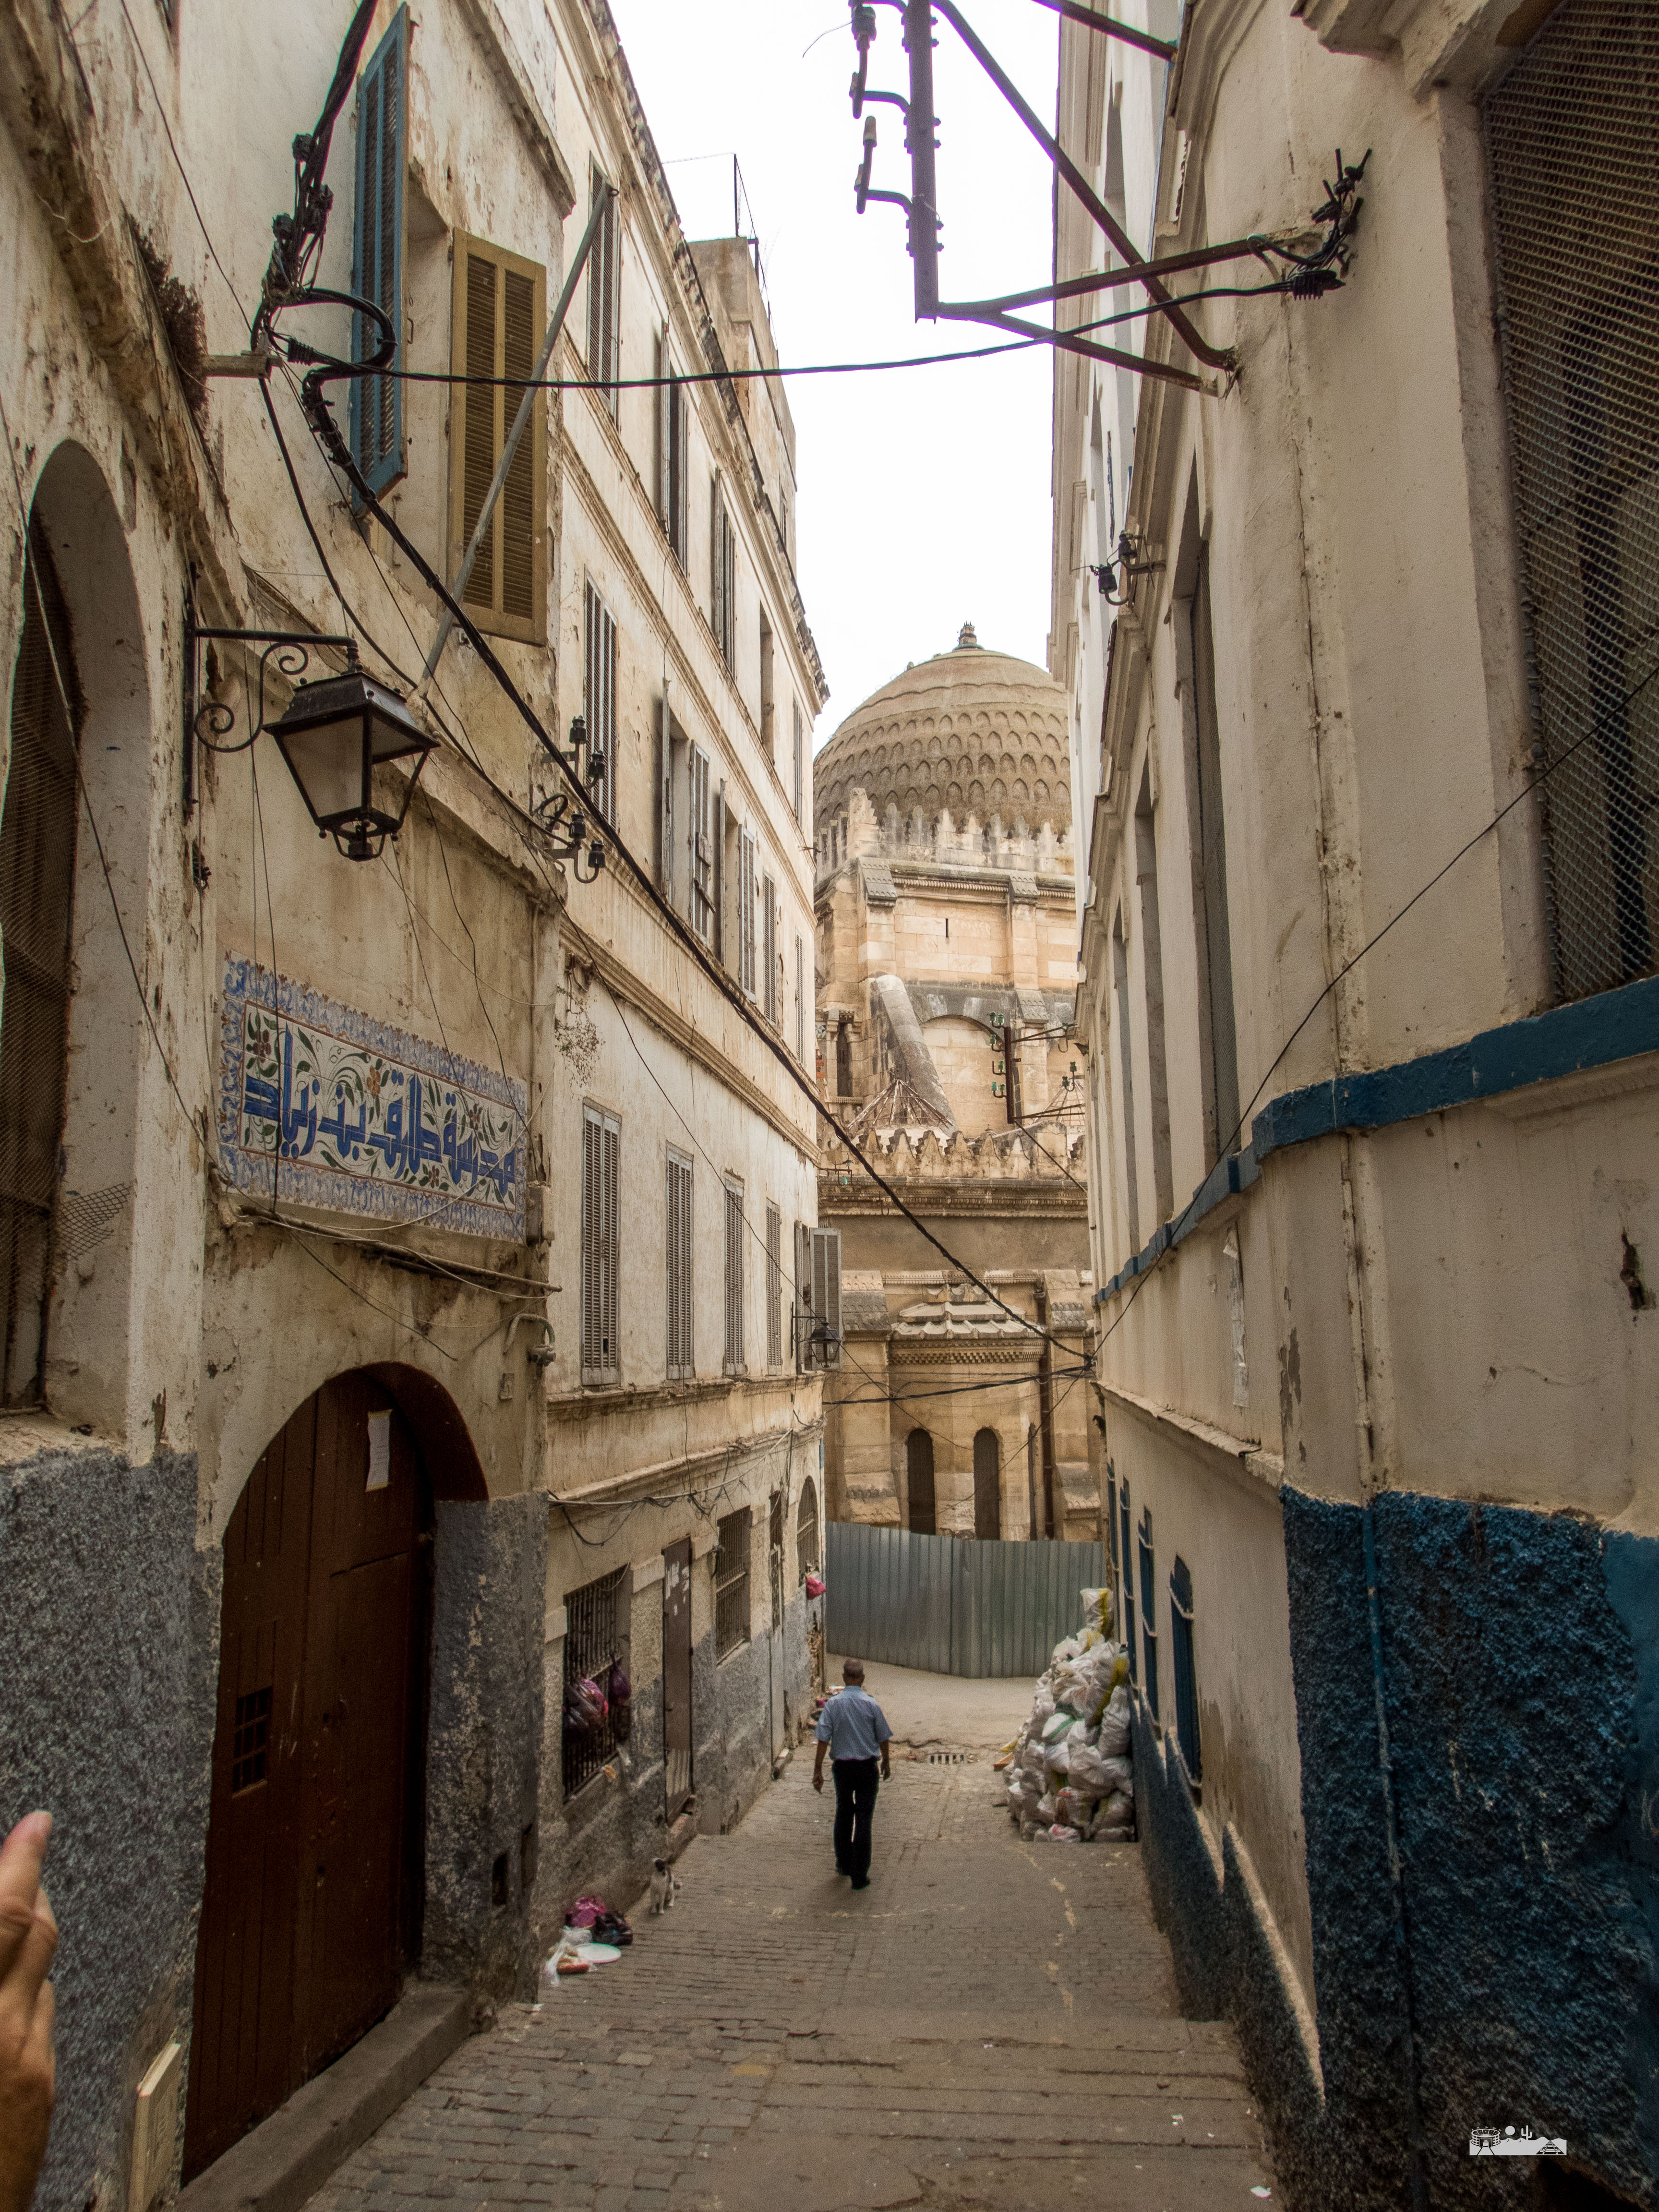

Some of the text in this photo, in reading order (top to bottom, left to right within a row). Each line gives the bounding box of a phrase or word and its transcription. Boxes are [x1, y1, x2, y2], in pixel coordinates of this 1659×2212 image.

[243, 1021, 515, 1197] مدرسة طارق بن زياد
